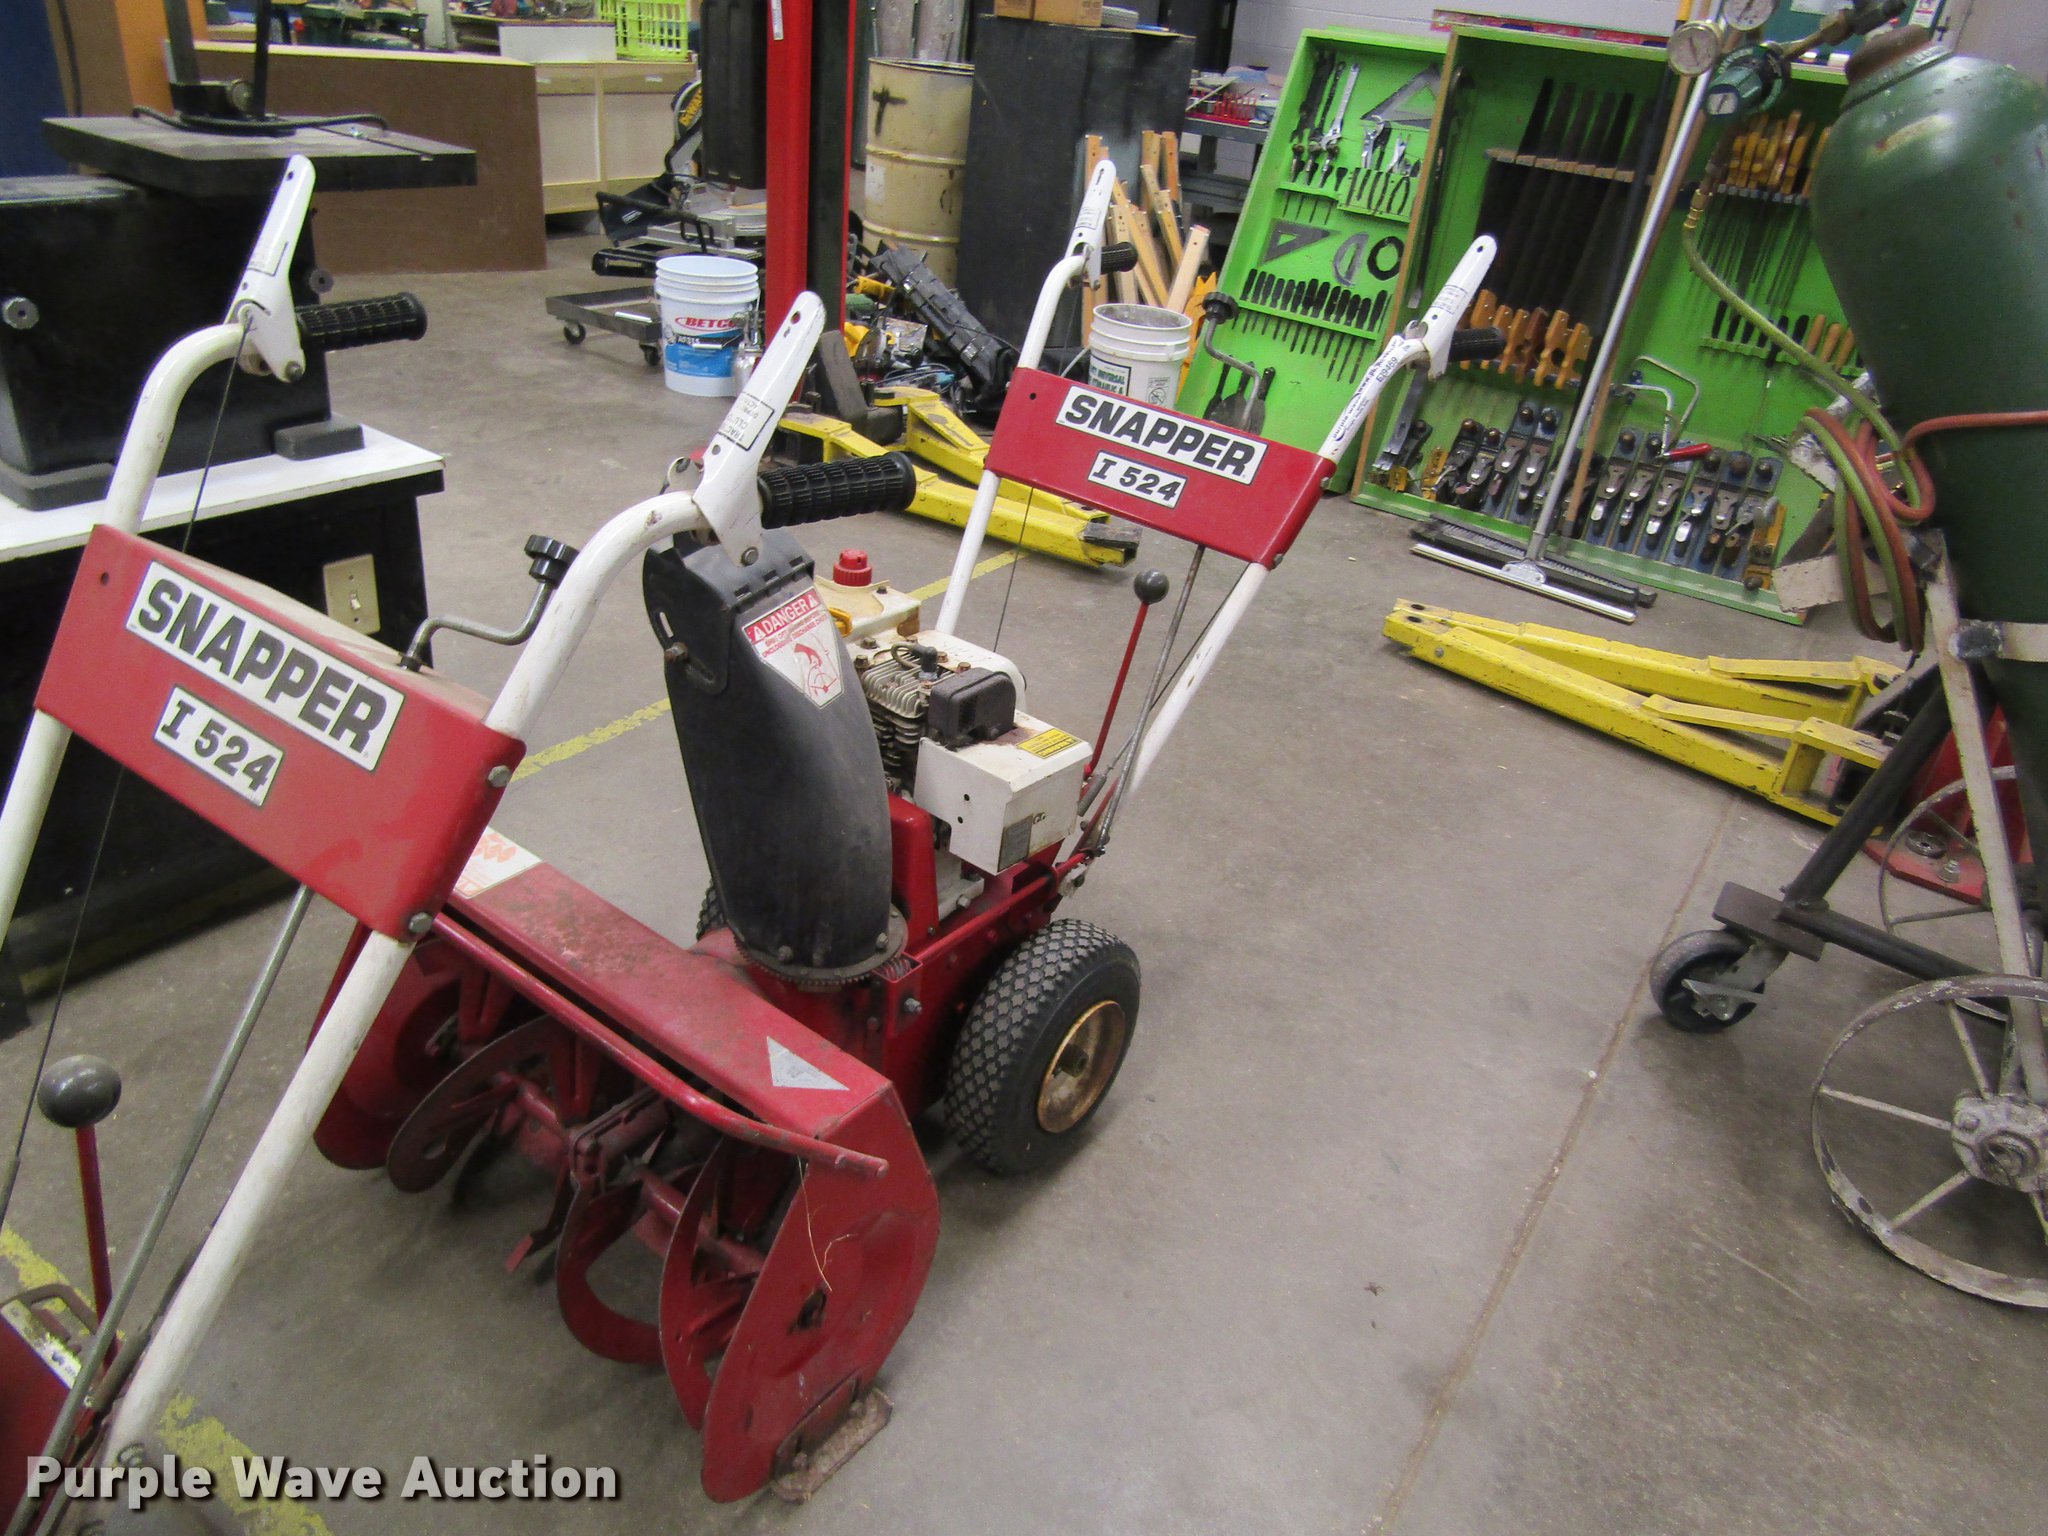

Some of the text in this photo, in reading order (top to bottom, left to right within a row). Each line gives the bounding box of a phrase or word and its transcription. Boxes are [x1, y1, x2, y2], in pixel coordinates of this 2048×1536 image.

[1065, 394, 1256, 477] SNAPPER
[1092, 458, 1182, 501] I 524
[760, 598, 809, 635] DANGER
[138, 578, 388, 754] SNAPPER
[161, 700, 277, 791] I 524
